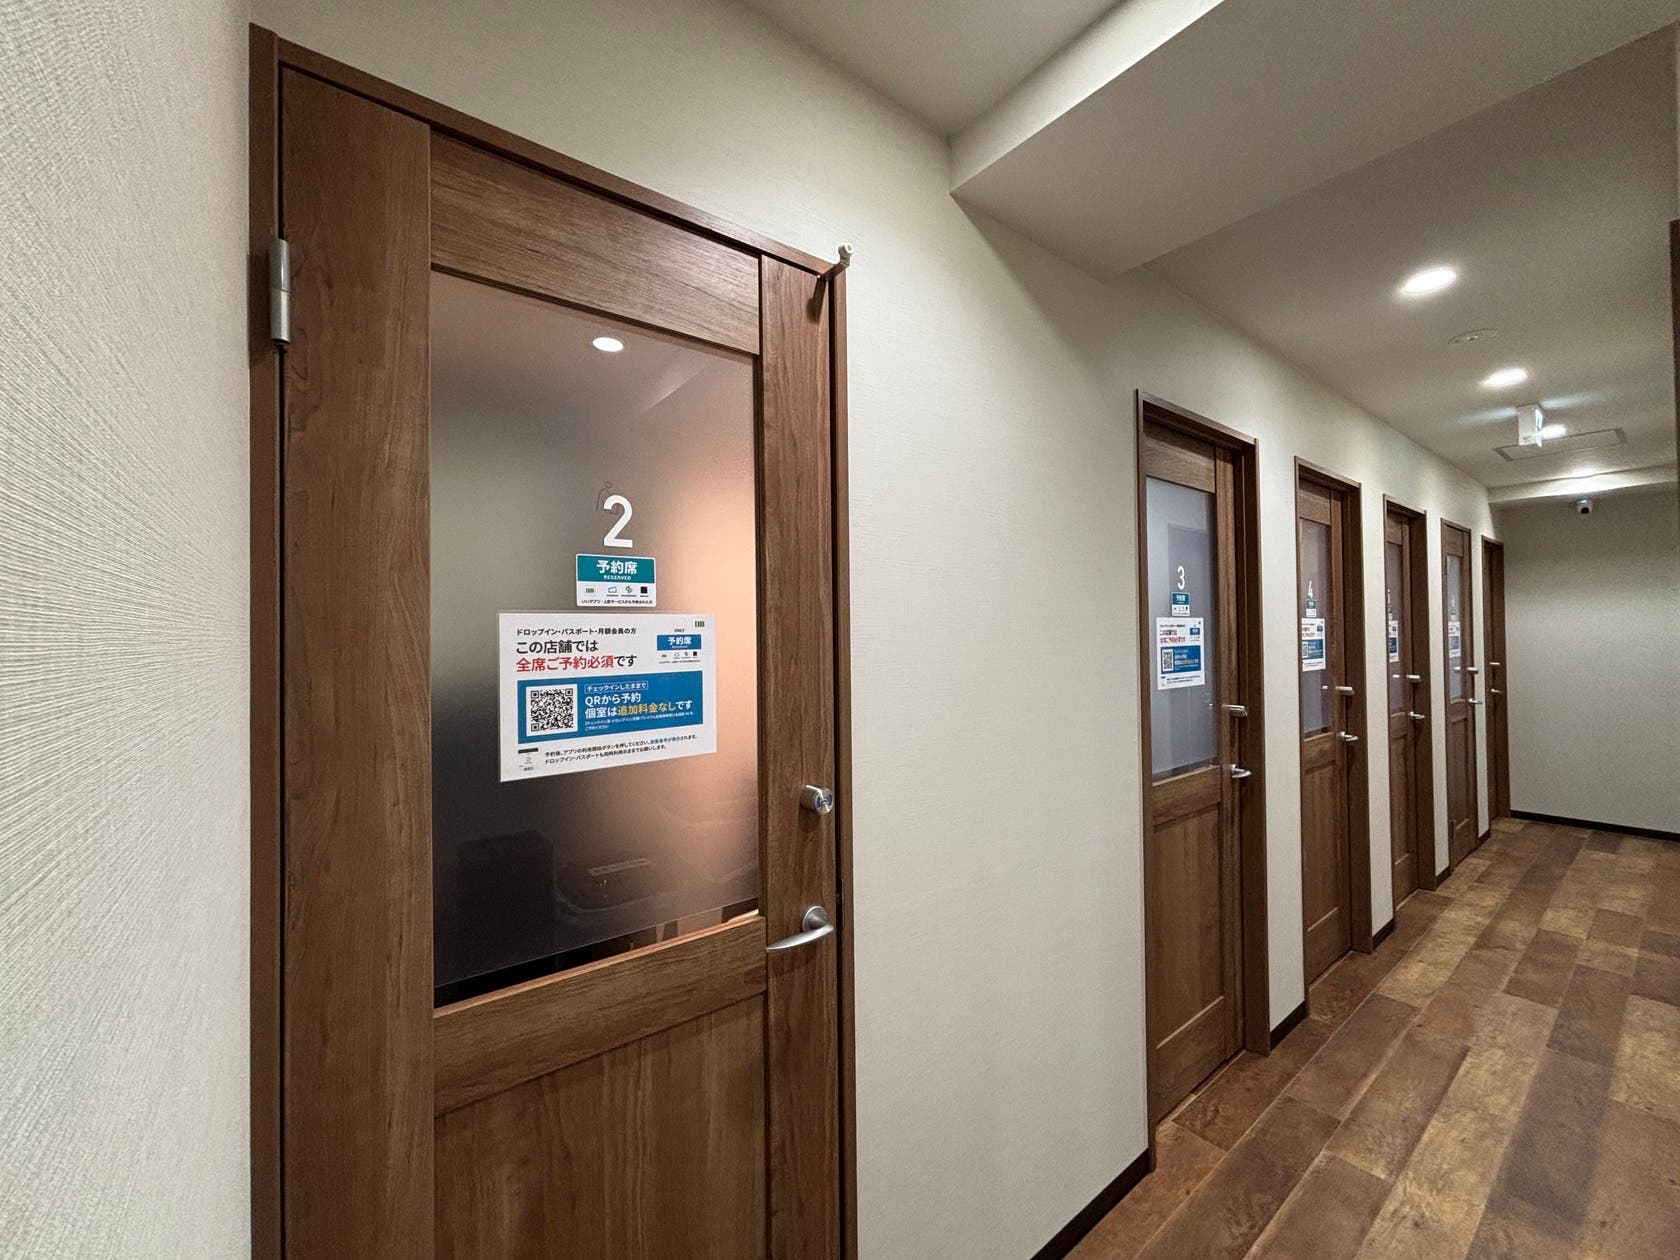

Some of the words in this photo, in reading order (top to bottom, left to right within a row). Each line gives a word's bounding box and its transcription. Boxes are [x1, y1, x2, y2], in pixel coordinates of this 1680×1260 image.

[603, 494, 633, 548] 2
[596, 559, 638, 575] 予約席
[1177, 565, 1185, 590] 3
[1307, 580, 1314, 599] 4
[516, 639, 599, 654] この店舗では
[516, 654, 638, 672] 全席ご予約必須です
[584, 692, 642, 708] QRから予約
[584, 700, 693, 719] 個室は追加料金なしです
